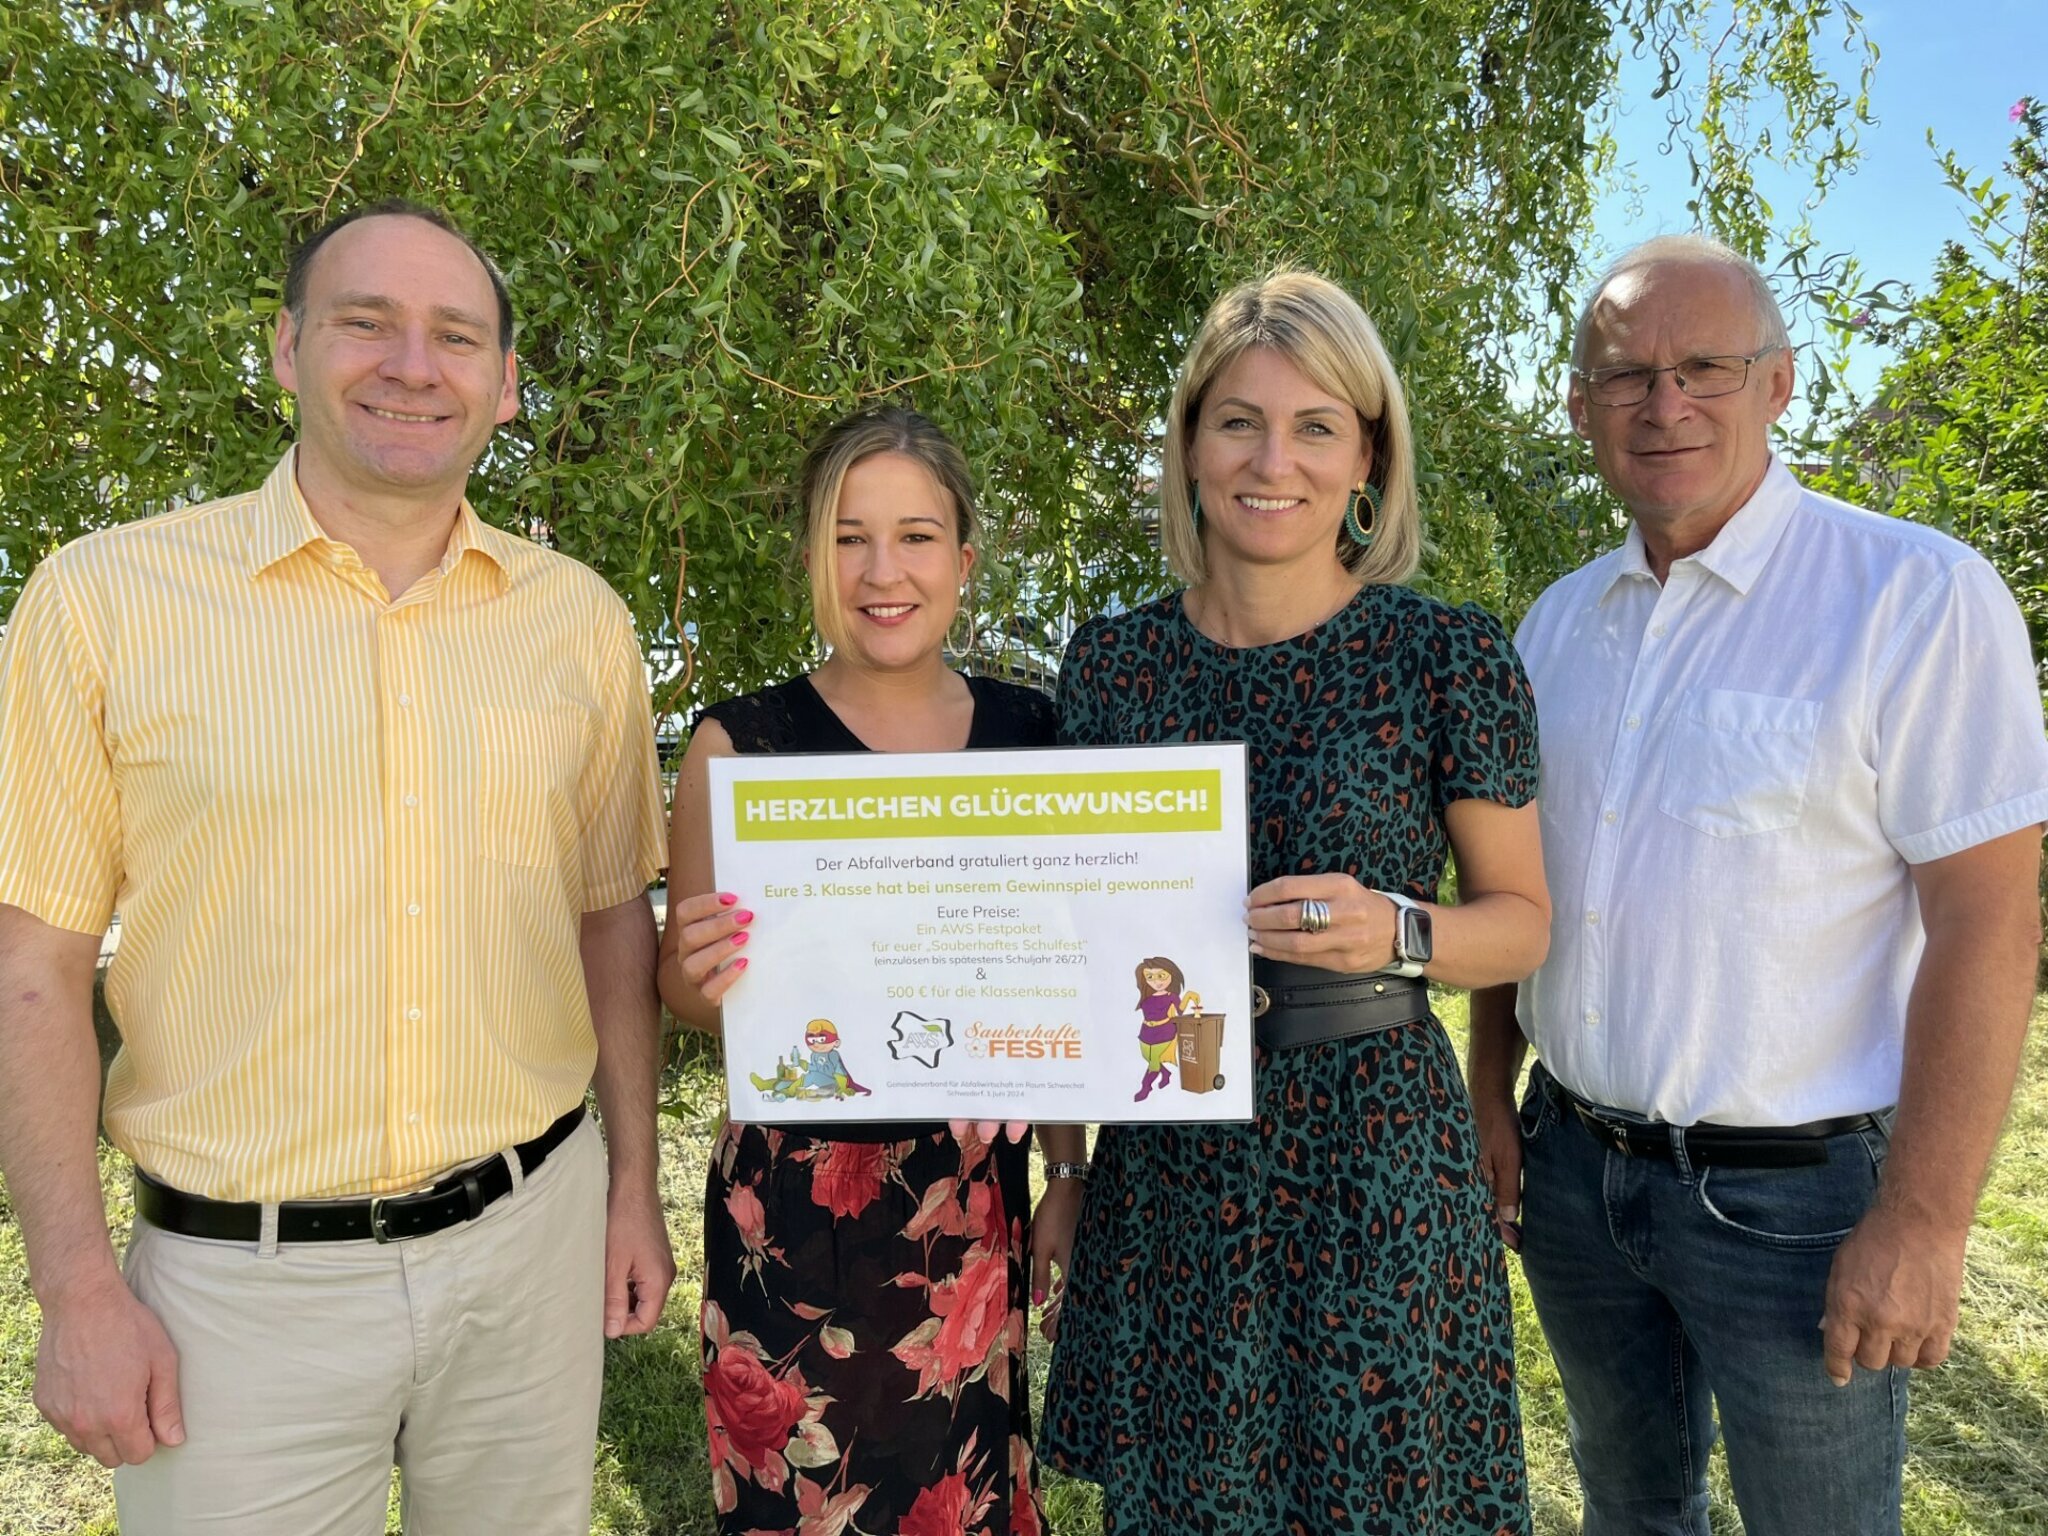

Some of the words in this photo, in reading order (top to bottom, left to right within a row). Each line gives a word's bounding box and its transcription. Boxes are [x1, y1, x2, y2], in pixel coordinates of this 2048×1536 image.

[745, 799, 941, 822] HERZLICHEN
[950, 788, 1207, 816] GLÜCKWUNSCH!
[816, 857, 843, 871] Der
[847, 854, 955, 870] Abfallverband
[959, 853, 1028, 871] gratuliert
[1033, 856, 1071, 870] ganz
[1075, 852, 1138, 867] herzlich!
[765, 883, 798, 898] Eure
[802, 884, 817, 897] 3.
[821, 882, 872, 897] Klasse
[876, 880, 903, 895] hat
[907, 880, 930, 894] bei
[935, 881, 1001, 893] unserem
[1006, 877, 1102, 897] Gewinnspiel
[1107, 876, 1193, 895] gewonnen!
[938, 906, 968, 918] Eure
[973, 906, 1020, 917] Preise:
[916, 924, 936, 934] Ein
[940, 923, 973, 934] AWS
[978, 923, 1041, 936] Festpaket
[872, 941, 888, 952] für
[933, 956, 947, 964] bis
[949, 956, 1003, 966] spätestens
[1006, 955, 1052, 965] Schuljahr
[1055, 955, 1087, 965] 26/27)
[976, 968, 986, 980] &
[887, 986, 914, 998] 500
[919, 986, 927, 997] €
[932, 985, 950, 998] für
[955, 986, 976, 997] die
[981, 985, 1077, 998] Klassenkassa
[965, 1021, 1080, 1039] Sauberhafte
[904, 1032, 939, 1048] AWS
[989, 1040, 1082, 1058] FESTE
